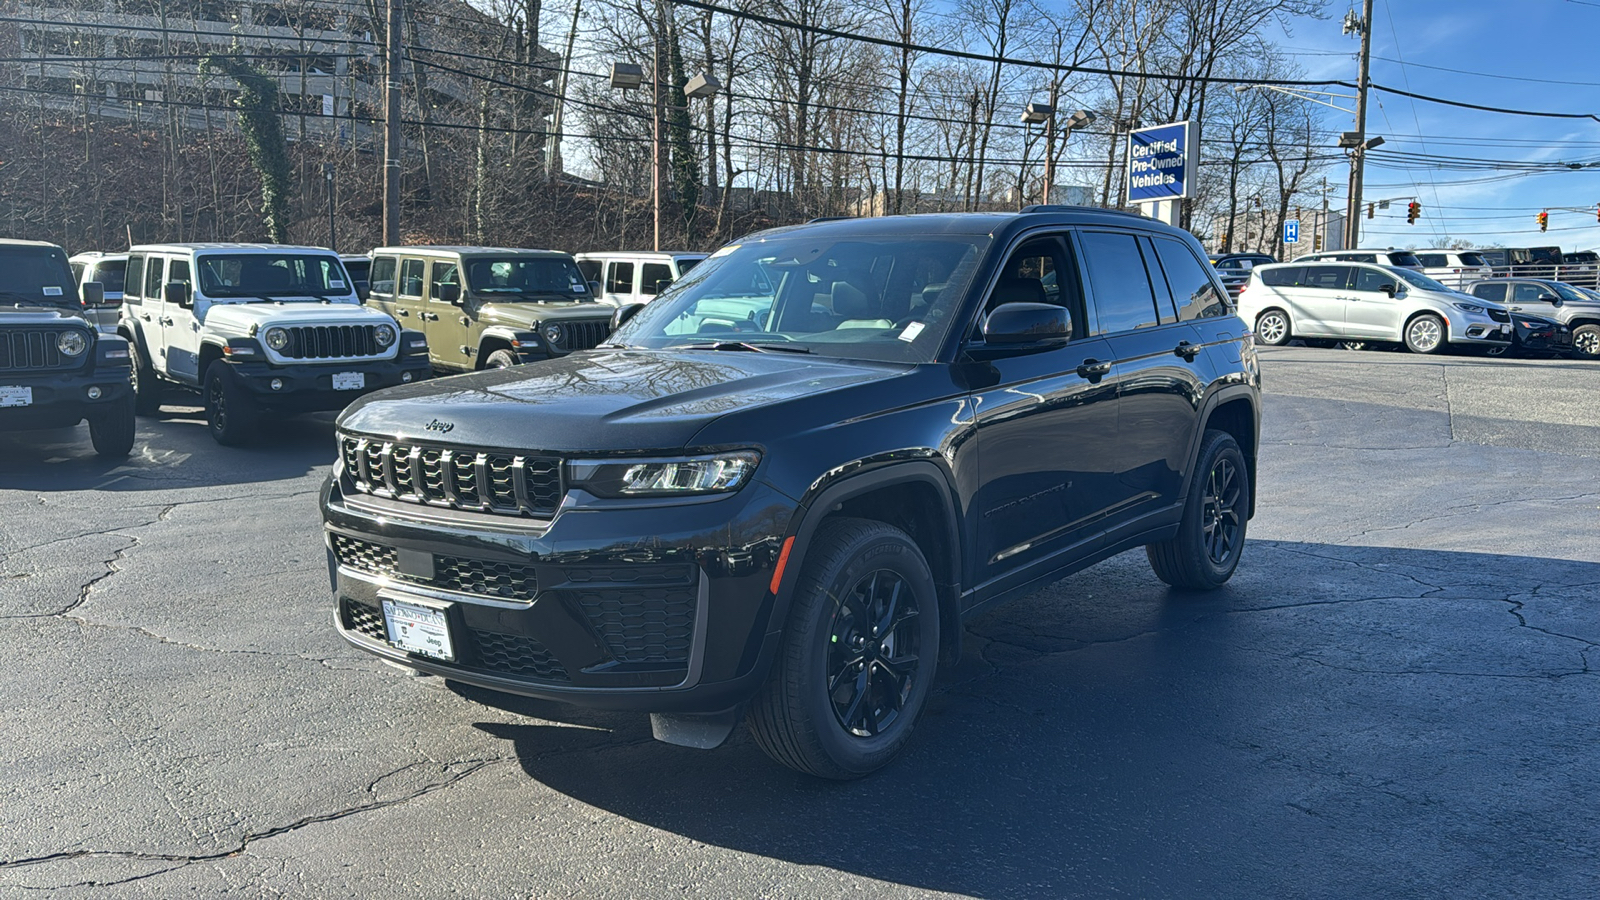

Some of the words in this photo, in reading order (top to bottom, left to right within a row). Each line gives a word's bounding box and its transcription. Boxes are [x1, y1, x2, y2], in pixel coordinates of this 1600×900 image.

[1132, 138, 1177, 157] Certified
[1132, 154, 1183, 173] Pre-Owned
[1132, 172, 1175, 188] Vehicles
[1287, 225, 1296, 237] H
[425, 419, 454, 433] Jeep
[426, 636, 442, 647] Jeep
